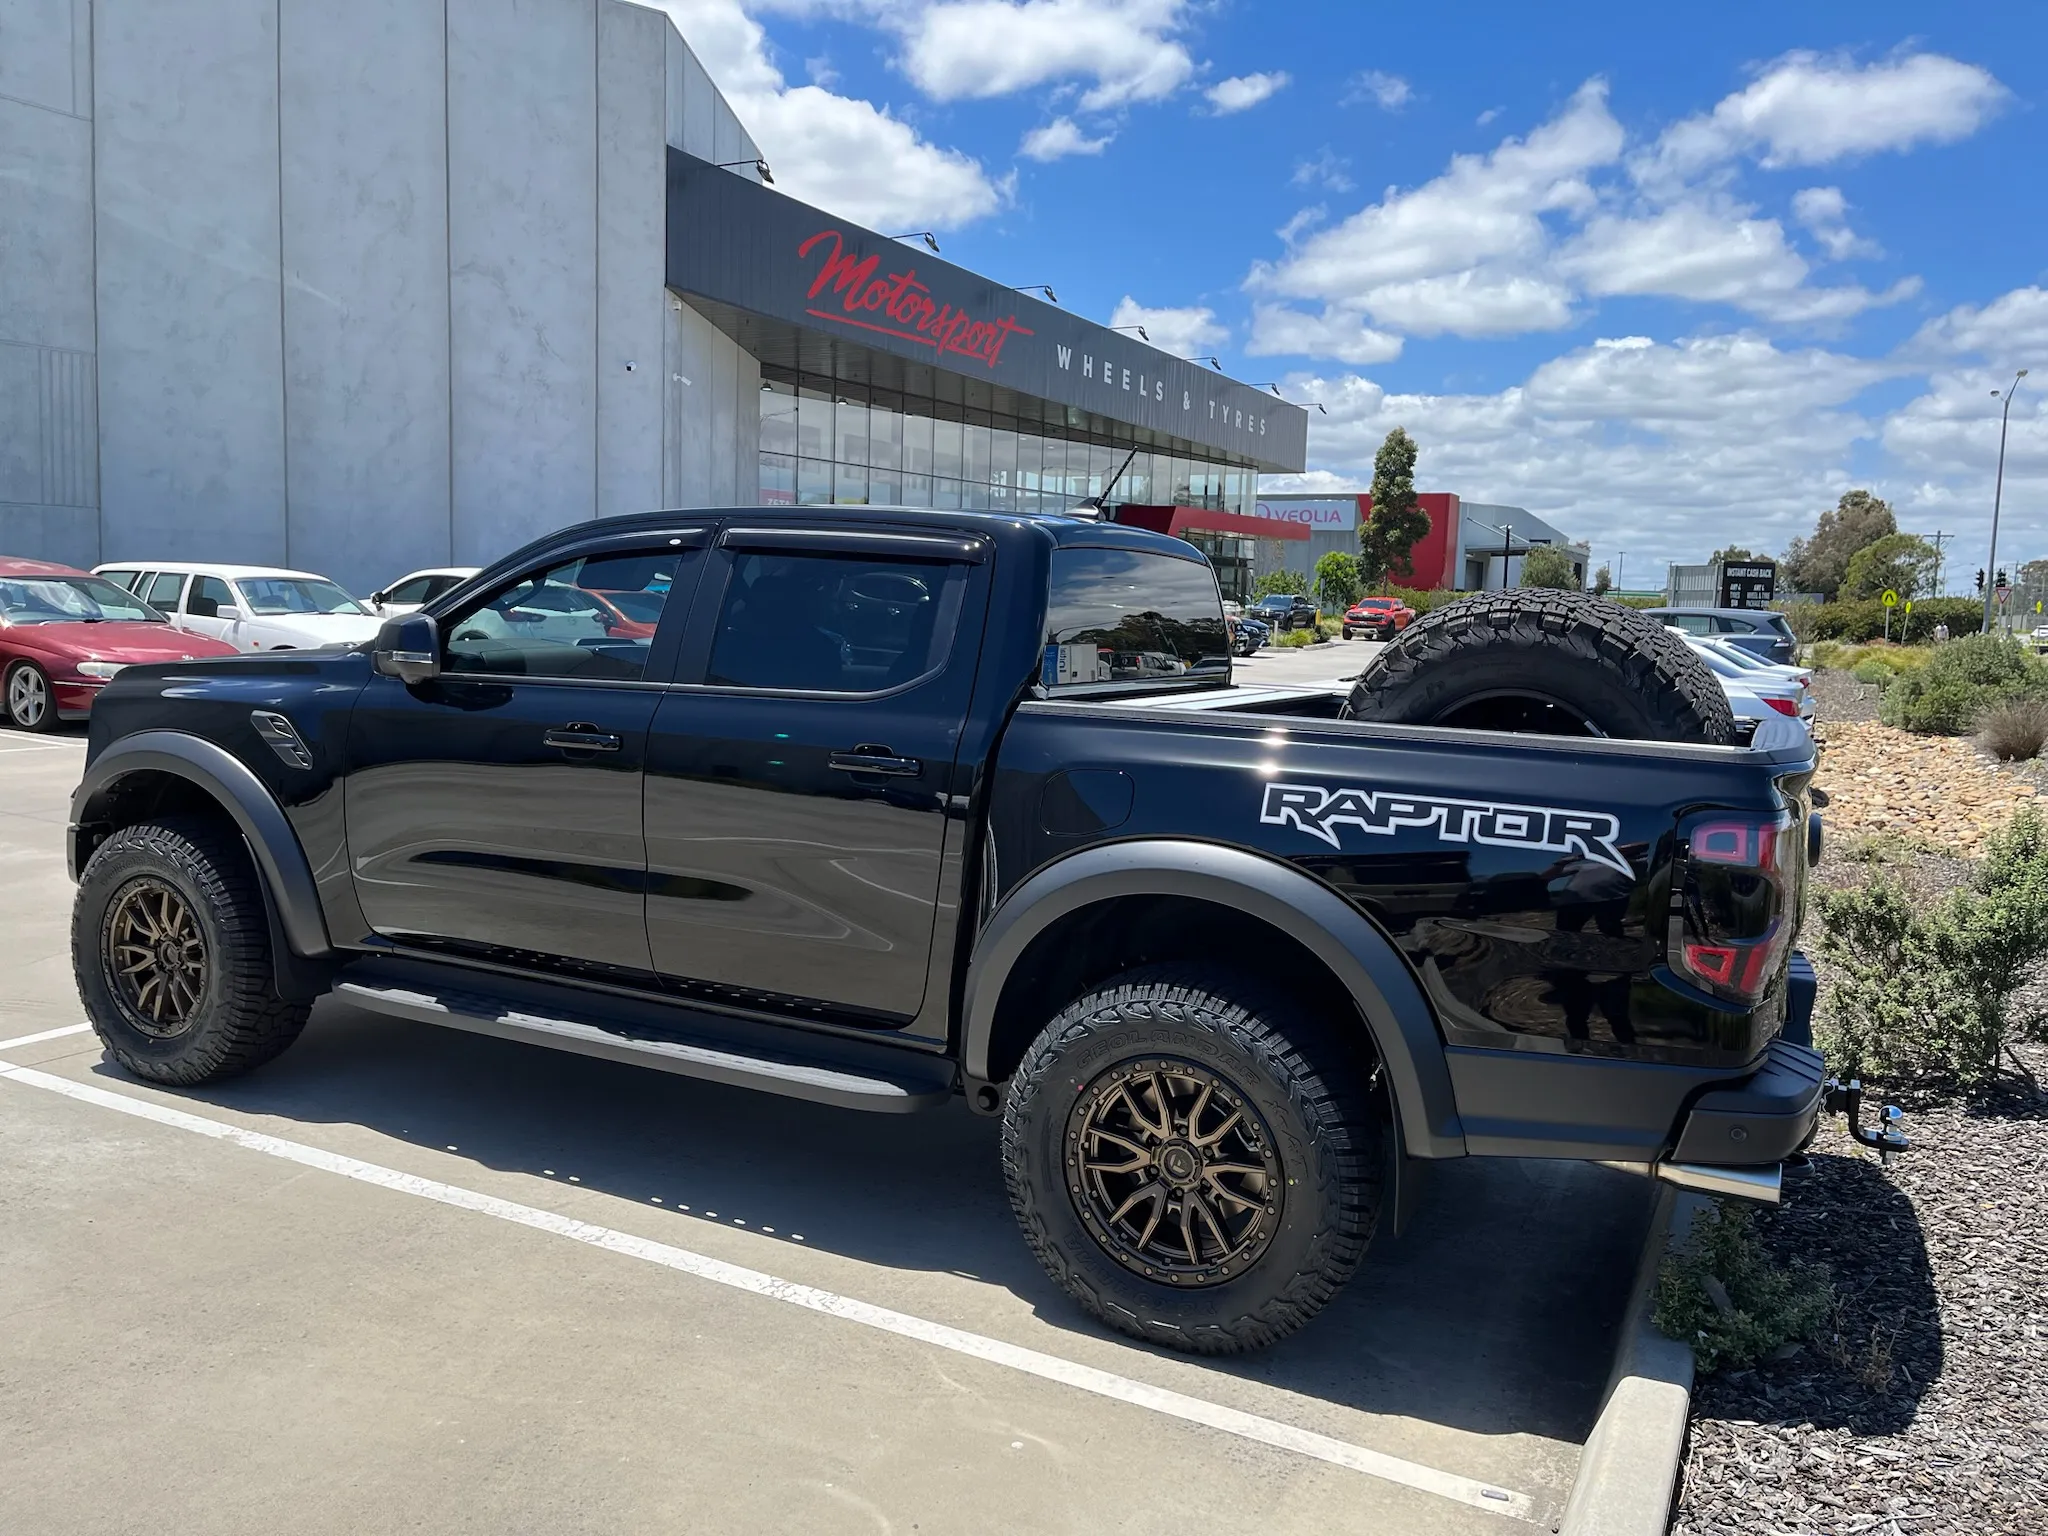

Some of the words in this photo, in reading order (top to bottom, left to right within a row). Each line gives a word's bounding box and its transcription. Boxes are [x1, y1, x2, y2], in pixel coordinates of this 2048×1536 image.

[798, 230, 1035, 368] Motorsport
[1057, 344, 1164, 401] WHEELS
[1183, 391, 1191, 410] &
[1209, 400, 1266, 436] TYRES
[1275, 508, 1342, 524] VEOLIA
[1727, 567, 1746, 577] INSTANT
[1747, 568, 1759, 578] CASH
[1759, 568, 1771, 578] BACK
[1259, 782, 1636, 882] RAPTOR
[1076, 1029, 1262, 1087] GEOLANDAR
